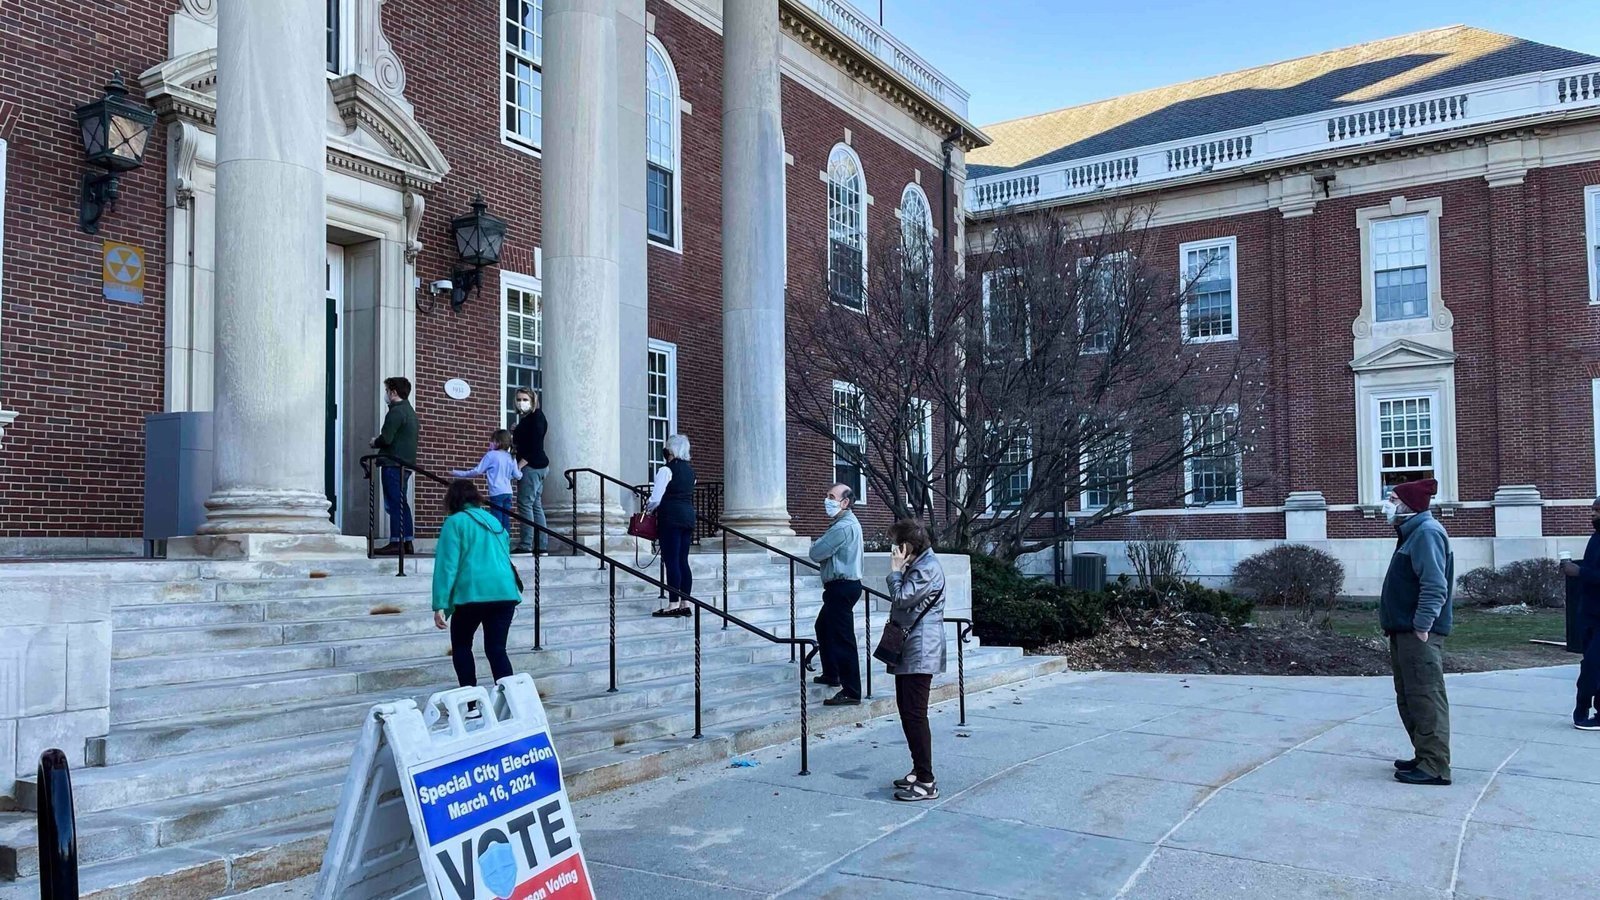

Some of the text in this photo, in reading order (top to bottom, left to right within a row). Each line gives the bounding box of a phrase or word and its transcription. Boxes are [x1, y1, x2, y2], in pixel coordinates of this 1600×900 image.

[419, 745, 553, 805] Special City Election
[448, 772, 537, 820] March 16, 2021
[545, 869, 578, 894] Voting
